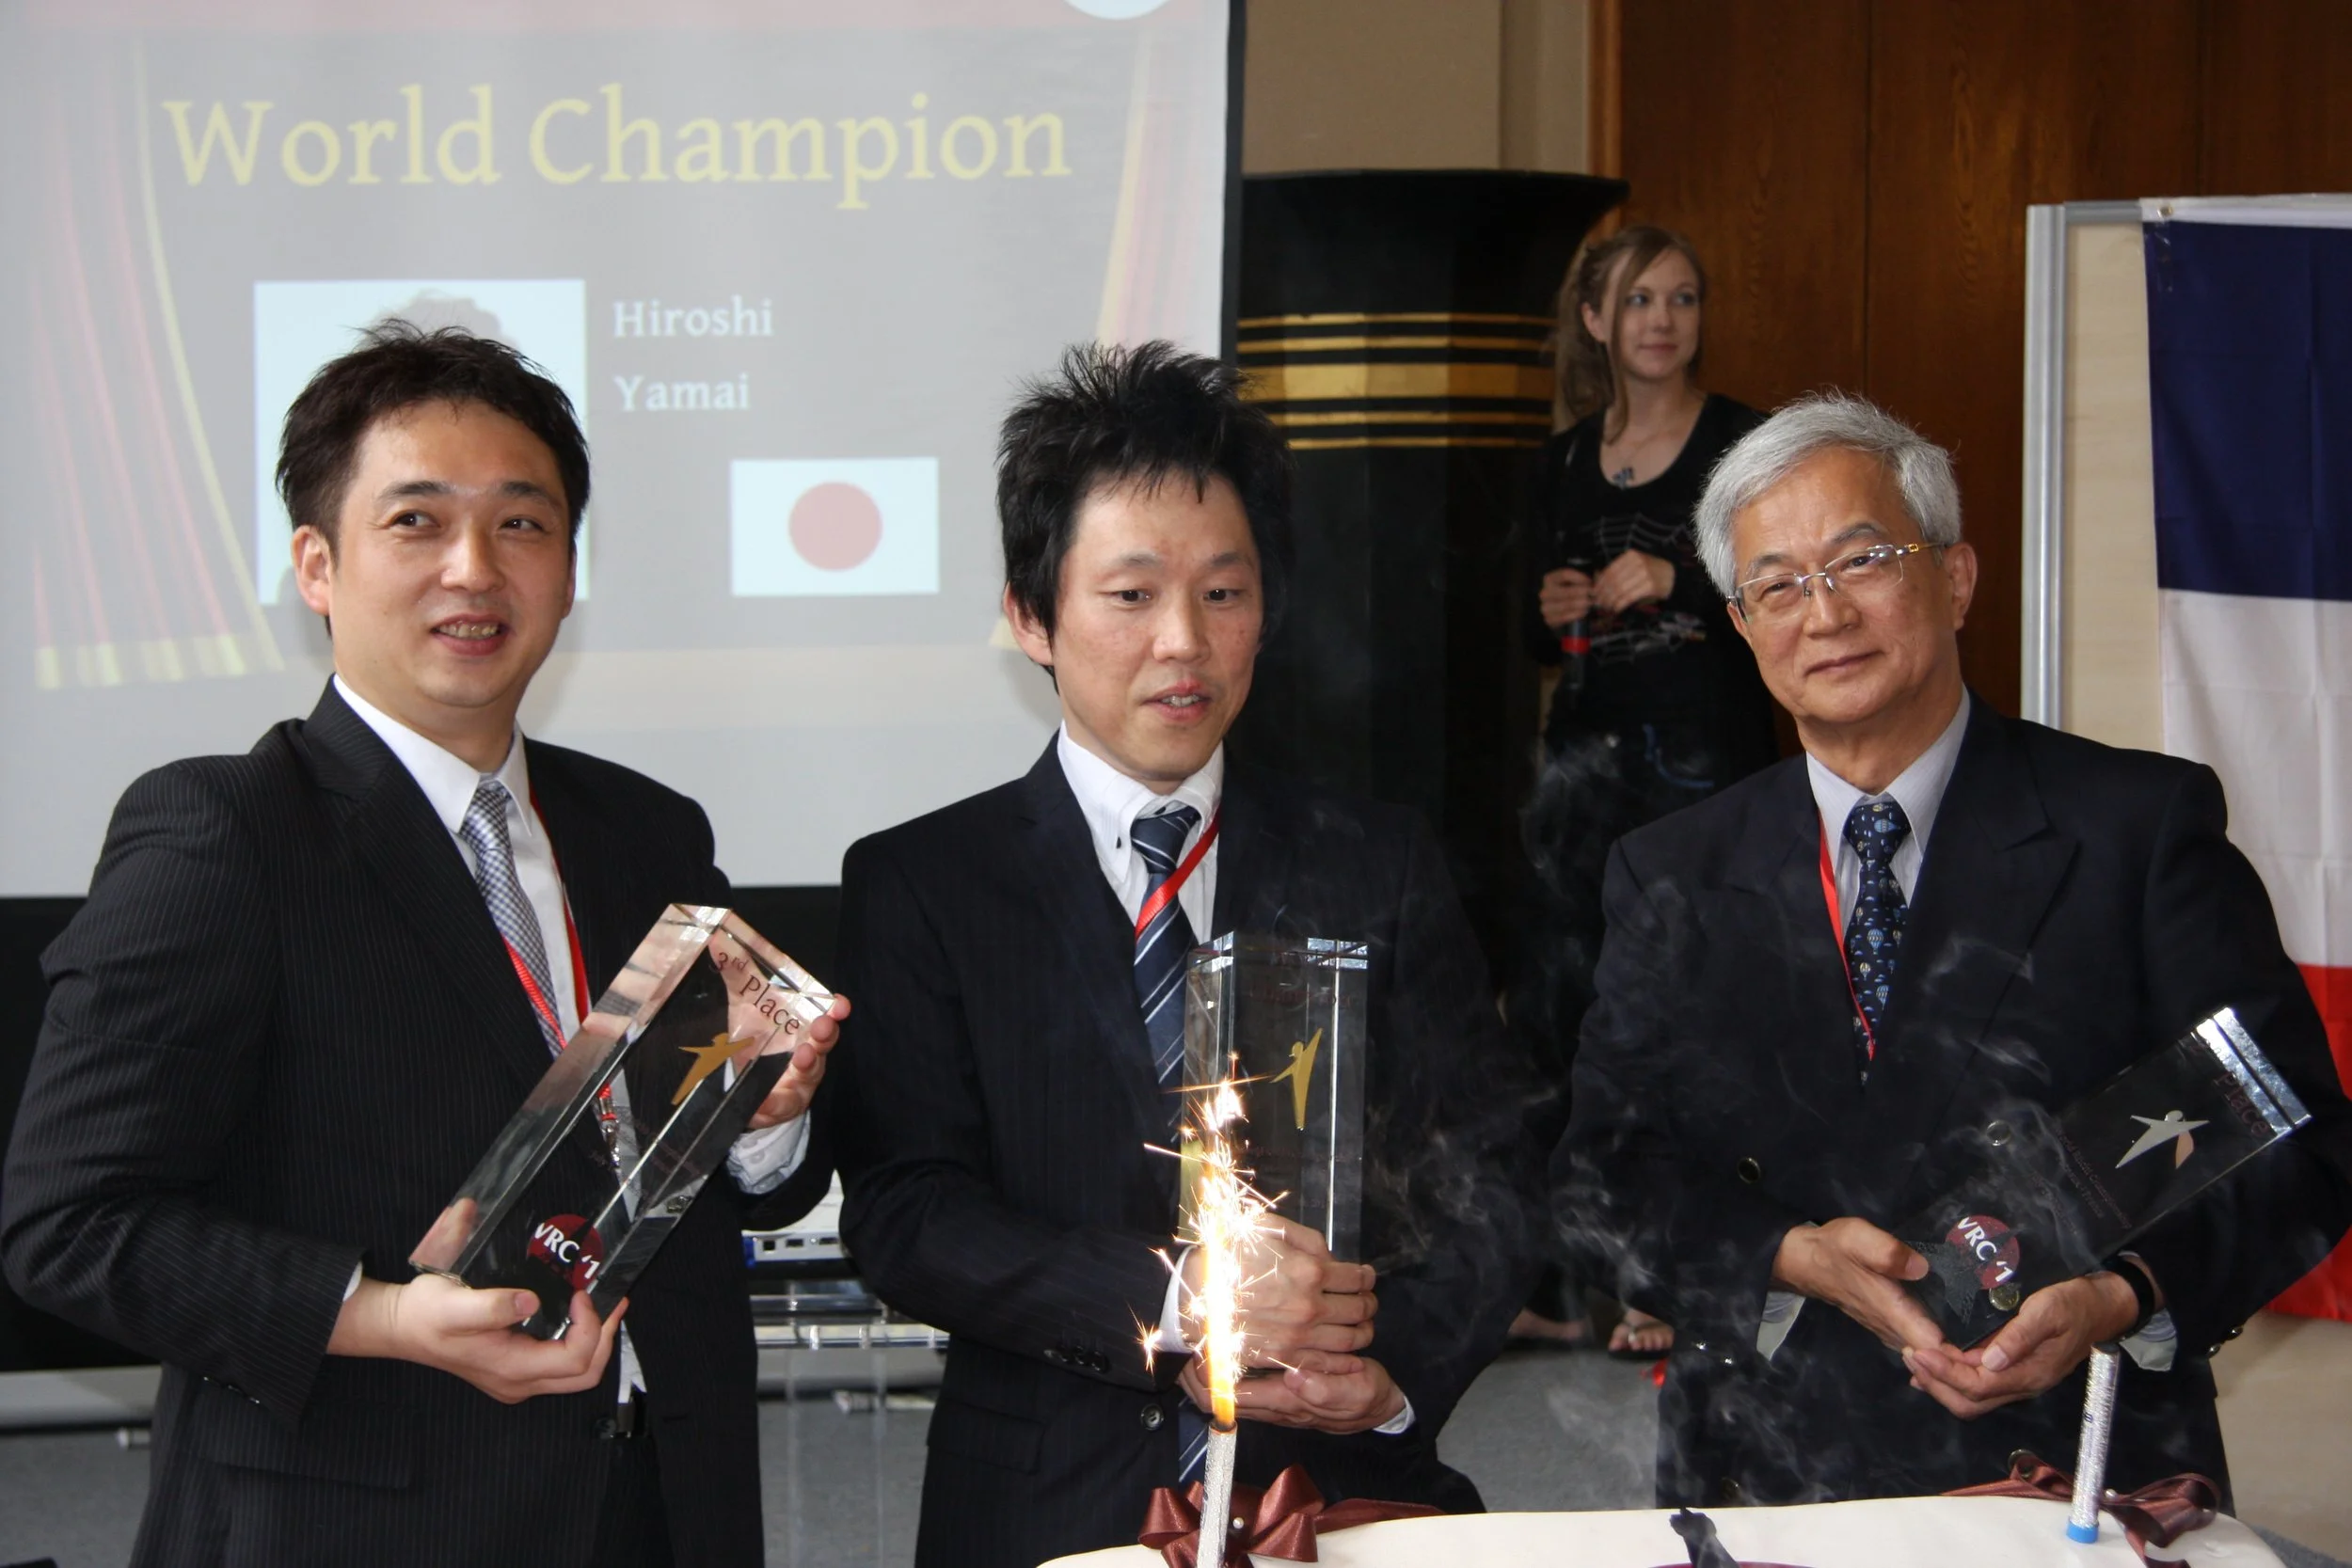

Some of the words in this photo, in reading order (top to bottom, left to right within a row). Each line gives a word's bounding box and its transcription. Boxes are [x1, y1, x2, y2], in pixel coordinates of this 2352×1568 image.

[160, 83, 502, 187] World
[529, 83, 1073, 210] Champion
[612, 293, 773, 338] Hiroshi
[613, 372, 750, 412] Yamai
[739, 974, 801, 1036] Place
[2212, 1071, 2269, 1136] Place
